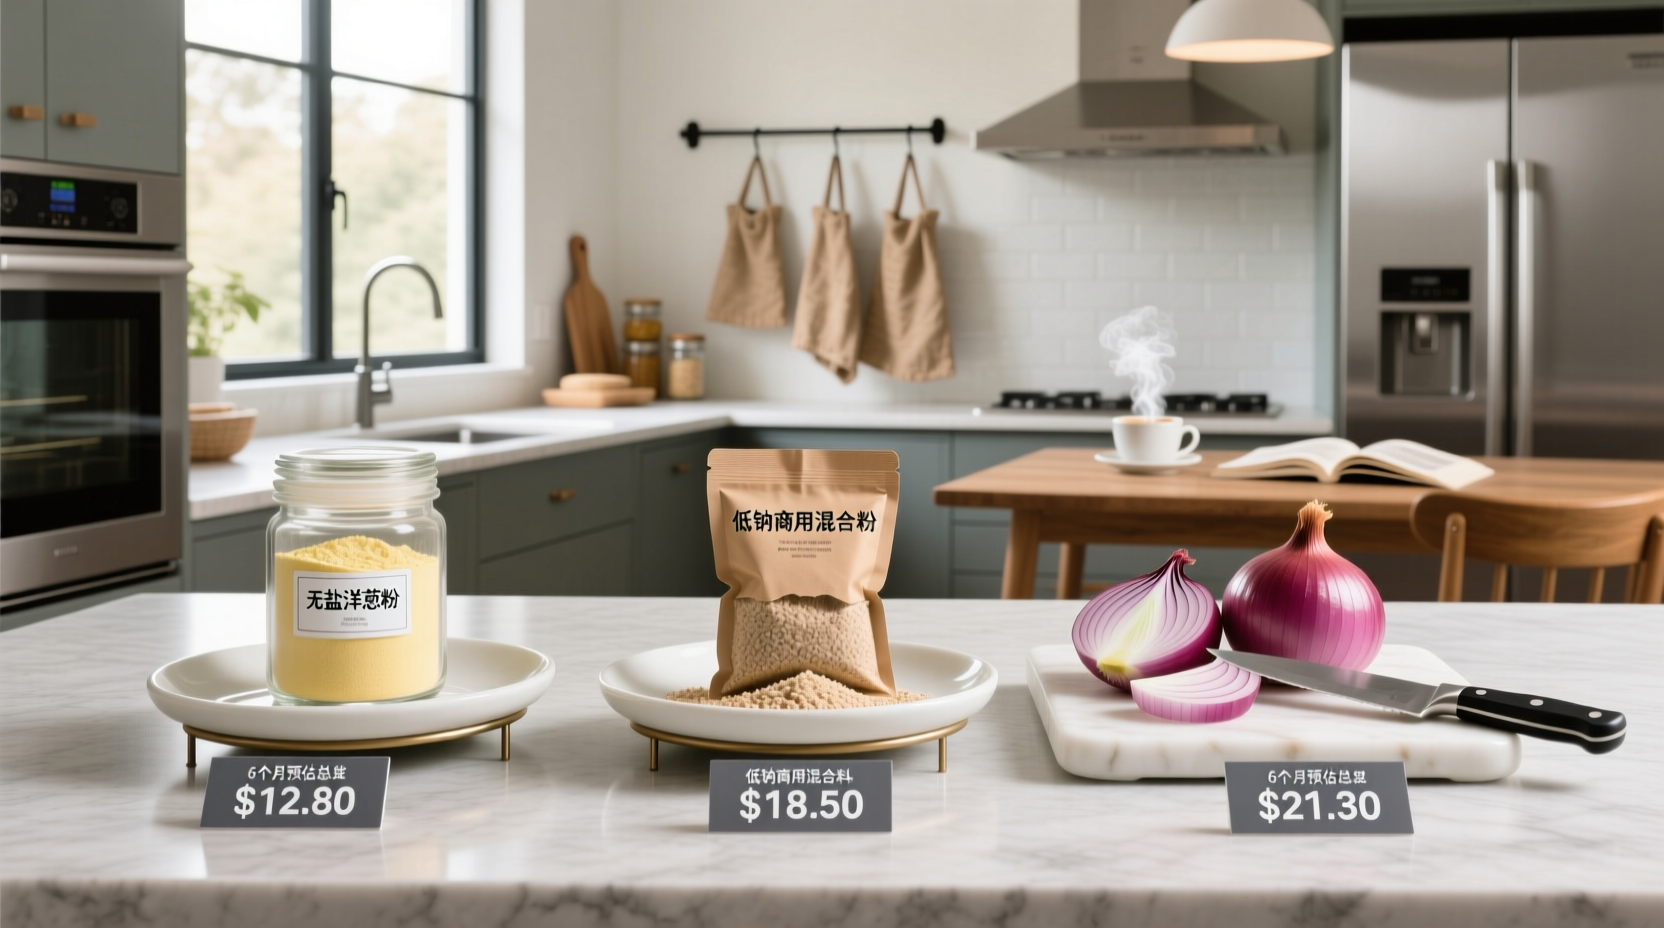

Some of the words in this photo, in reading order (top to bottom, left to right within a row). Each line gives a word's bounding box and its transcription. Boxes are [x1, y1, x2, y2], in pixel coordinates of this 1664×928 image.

[732, 509, 877, 533] 低钠商用混合粉
[306, 588, 400, 611] 无盐洋葱粉
[233, 783, 356, 819] $12.80
[739, 786, 864, 823] $18.50
[1258, 787, 1381, 824] $21.30
